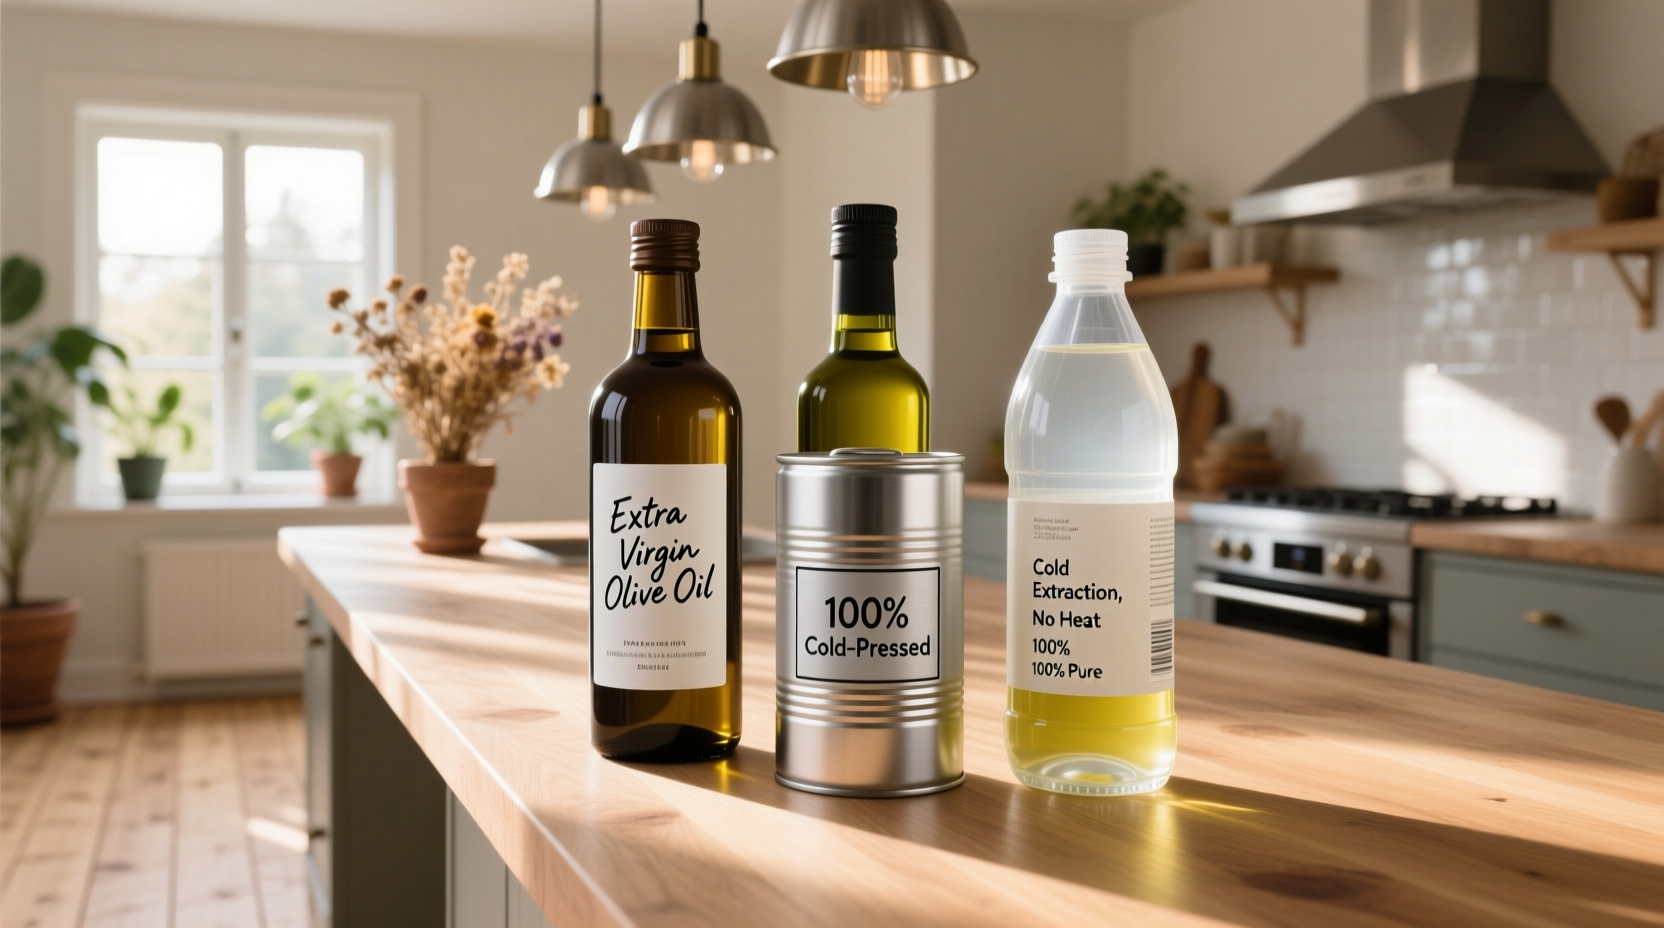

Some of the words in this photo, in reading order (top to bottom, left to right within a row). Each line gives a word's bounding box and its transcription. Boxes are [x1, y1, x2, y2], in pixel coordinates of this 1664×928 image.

[610, 495, 687, 534] Extra
[620, 535, 700, 583] Virgin
[1033, 558, 1070, 576] Cold
[605, 575, 667, 610] Olive
[674, 563, 715, 604] Oil
[1033, 581, 1123, 604] Extraction,
[825, 595, 909, 629] 100%
[1032, 609, 1055, 626] No
[1060, 610, 1101, 628] Heat
[805, 634, 931, 658] Cold-Pressed
[1032, 638, 1070, 656] 100%
[1032, 661, 1065, 678] 100%
[1068, 663, 1103, 679] Pure
